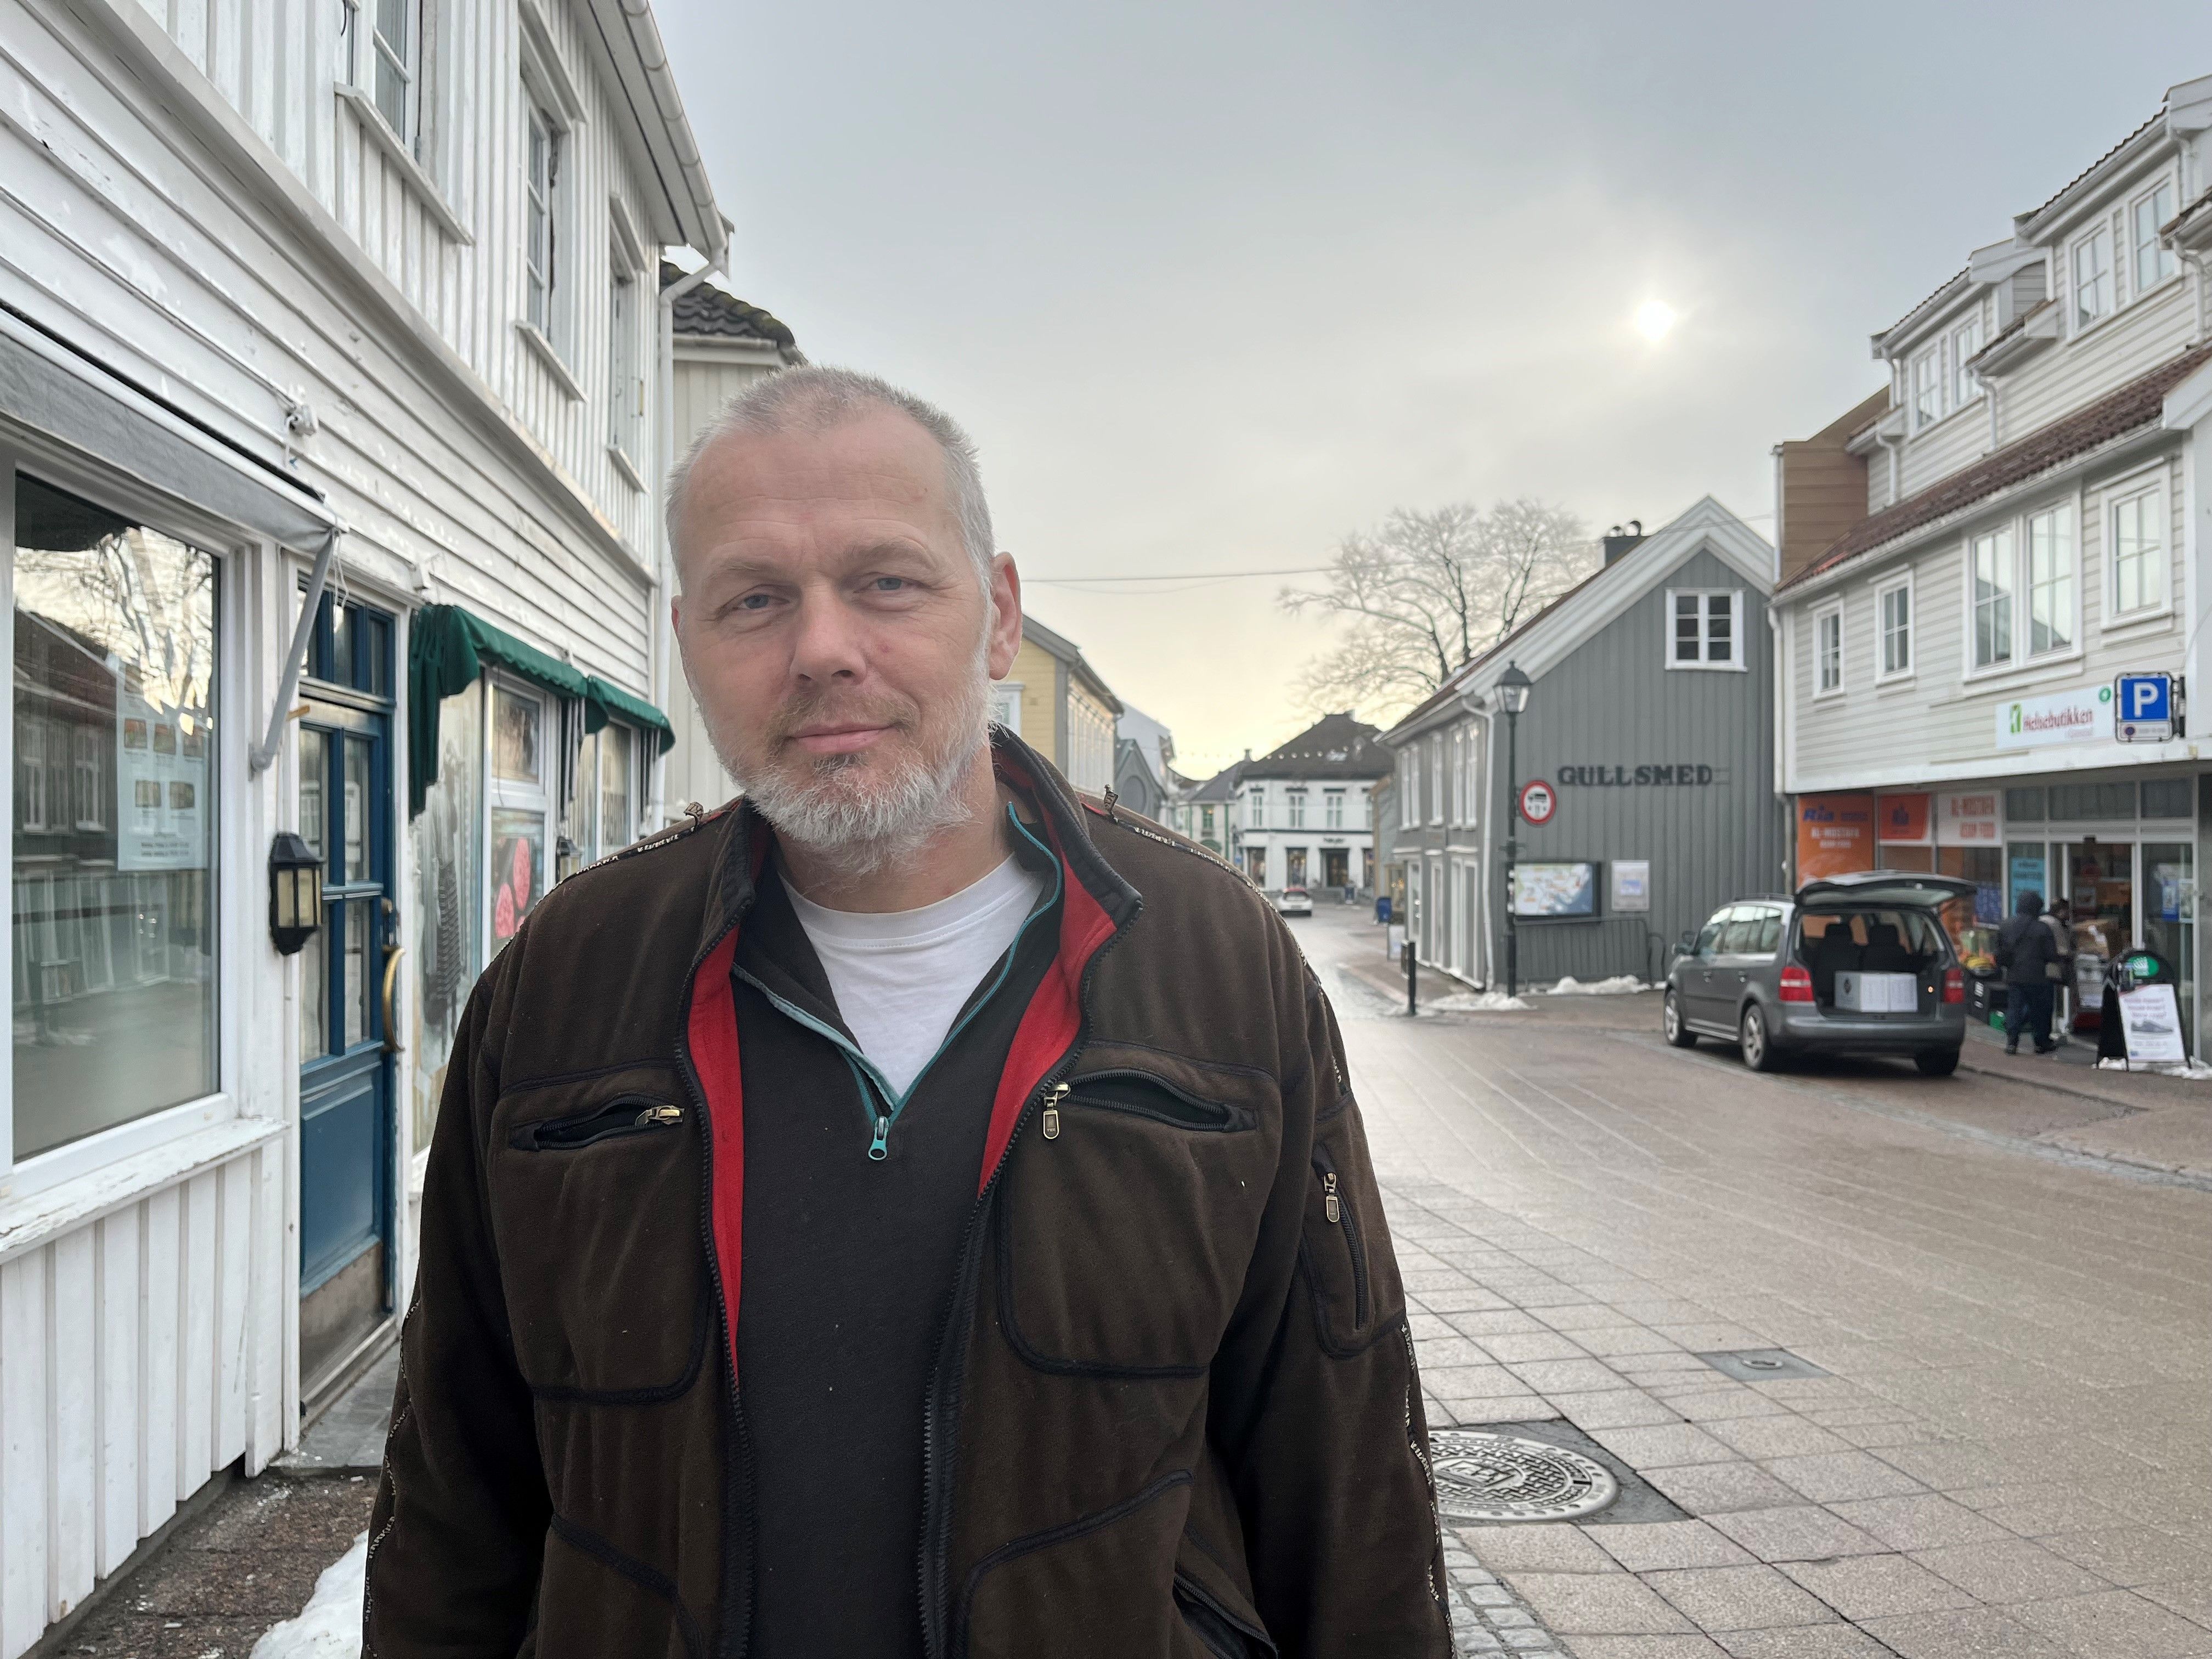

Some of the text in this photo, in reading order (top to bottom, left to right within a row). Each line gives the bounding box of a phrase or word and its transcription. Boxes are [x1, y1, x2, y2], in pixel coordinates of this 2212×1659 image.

[2134, 682, 2159, 718] P
[2023, 706, 2094, 730] Helsebutikken
[1557, 764, 1713, 786] GULLSMED
[1803, 804, 1834, 821] Ria
